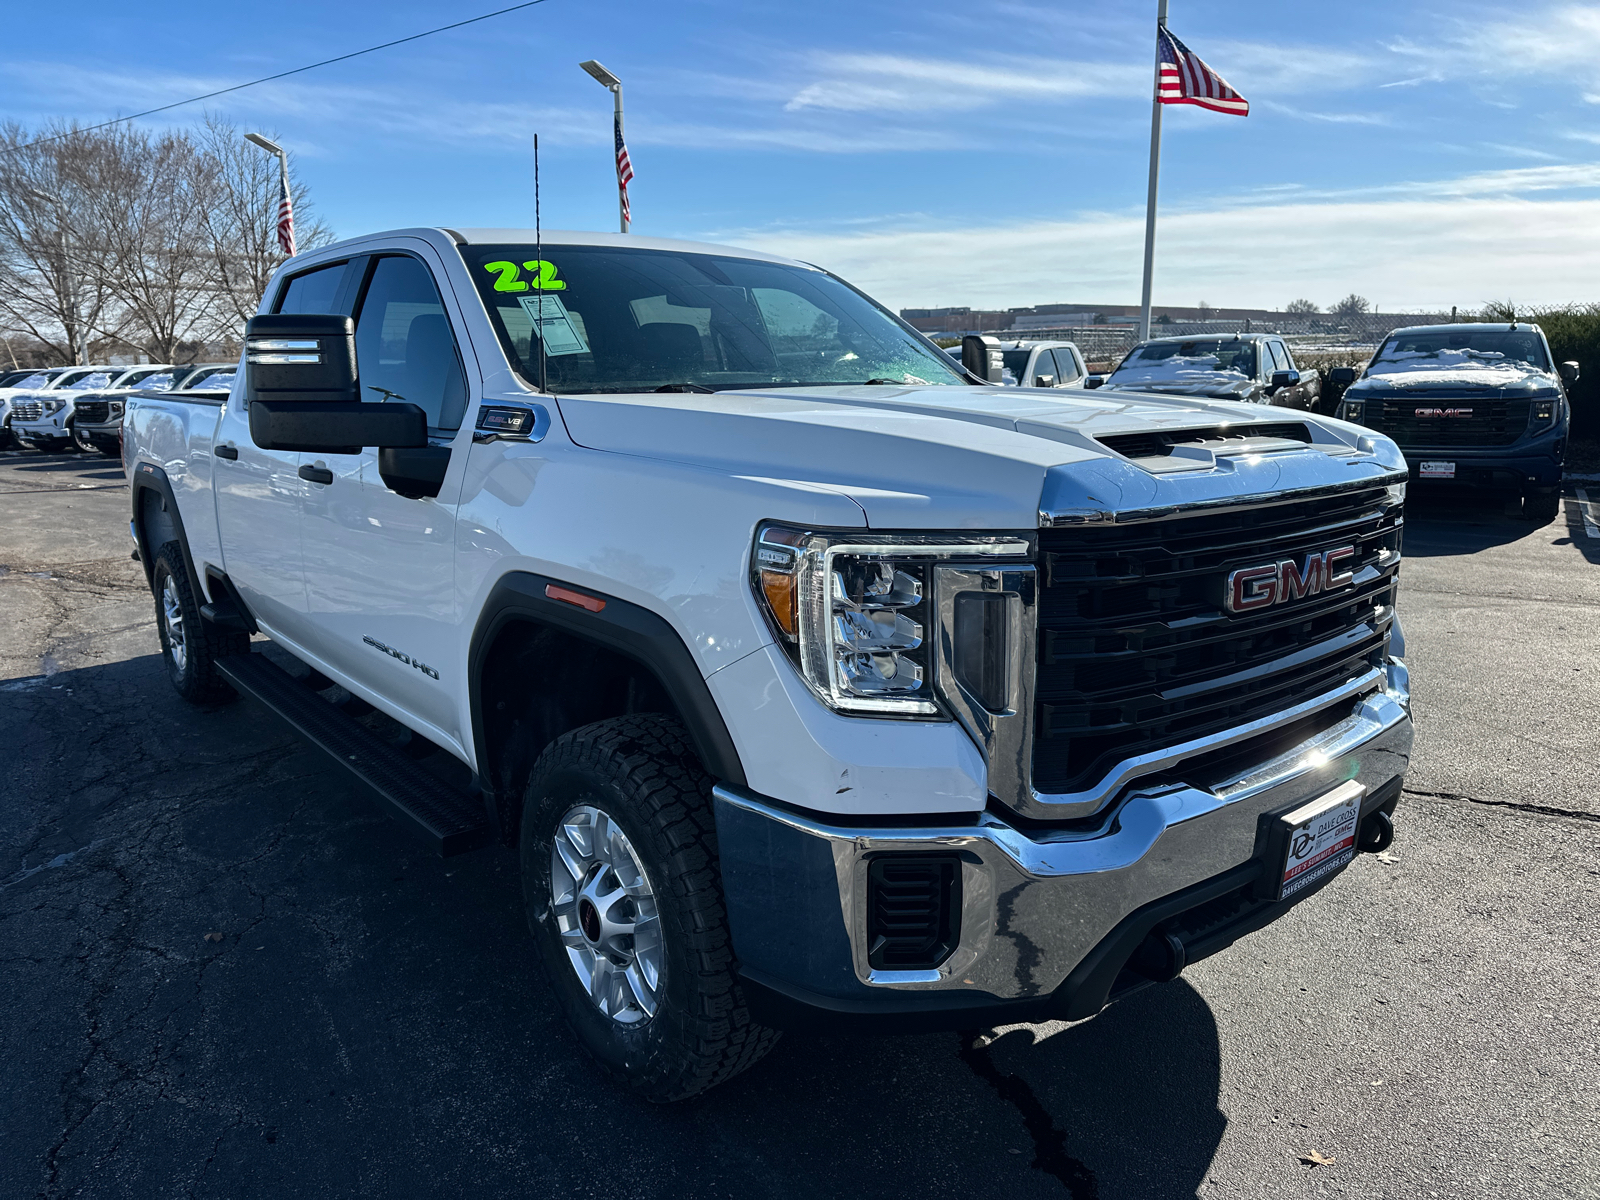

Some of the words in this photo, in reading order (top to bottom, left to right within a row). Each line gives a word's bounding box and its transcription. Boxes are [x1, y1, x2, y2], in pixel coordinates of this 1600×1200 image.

[484, 260, 566, 292] 22
[1415, 408, 1473, 418] GMC
[1228, 545, 1354, 613] GMC
[362, 634, 411, 665] 2500
[412, 658, 440, 680] HD
[1318, 819, 1336, 834] DAVE
[1336, 807, 1357, 823] CROSS
[1335, 822, 1353, 836] GMC
[1333, 841, 1344, 851] MO
[1282, 851, 1353, 897] DAVECROSSMOTORS.COM
